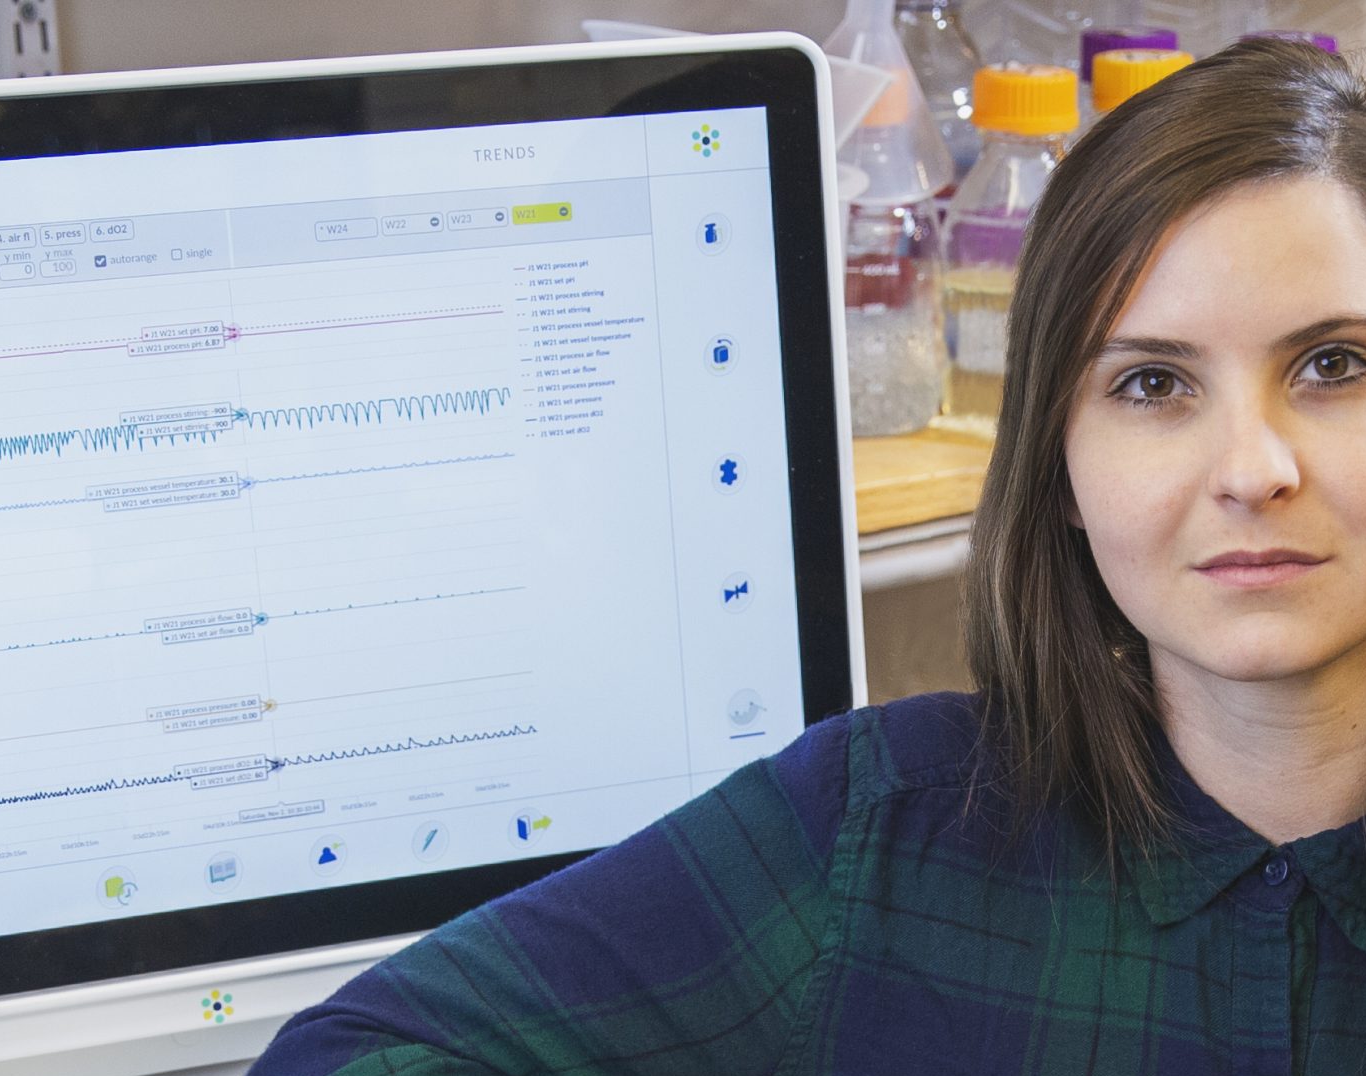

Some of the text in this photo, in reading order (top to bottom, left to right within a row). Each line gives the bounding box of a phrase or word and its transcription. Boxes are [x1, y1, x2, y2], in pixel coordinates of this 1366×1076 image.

[473, 146, 536, 162] TRENDS
[451, 214, 472, 225] W23
[516, 209, 536, 219] W21
[95, 224, 128, 236] 6. dO2
[327, 224, 348, 235] W24
[385, 219, 406, 230] W22
[7, 232, 22, 243] air
[44, 229, 82, 242] 5. press
[11, 251, 31, 261] min
[52, 248, 74, 258] max
[185, 248, 213, 260] single
[109, 252, 158, 268] autorange
[24, 264, 33, 275] 0
[52, 261, 73, 273] 100
